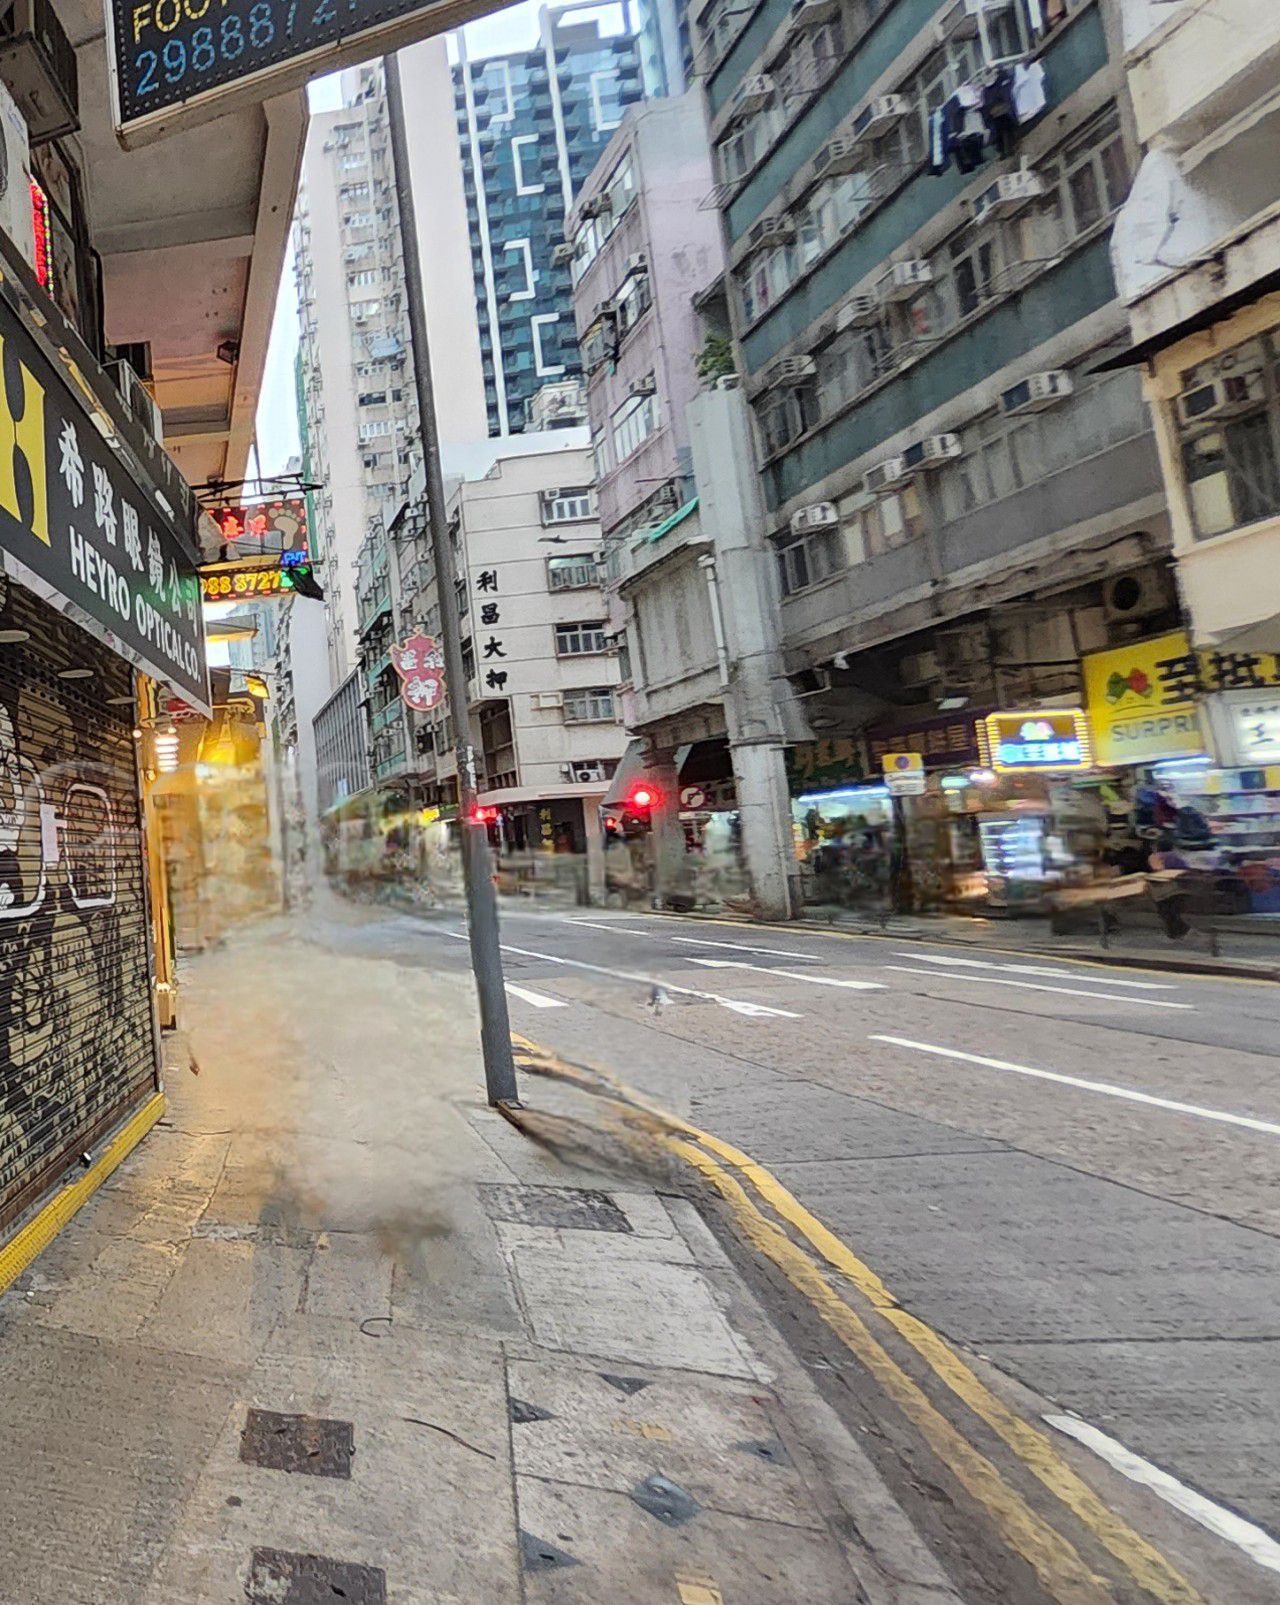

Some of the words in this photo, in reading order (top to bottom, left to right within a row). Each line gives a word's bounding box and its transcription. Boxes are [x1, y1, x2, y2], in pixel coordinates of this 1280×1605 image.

[69, 525, 131, 621] HEYRO
[136, 593, 185, 670] OPTICAL
[185, 641, 201, 684] CO.
[234, 571, 281, 592] 8727
[476, 570, 508, 692] 利昌大押
